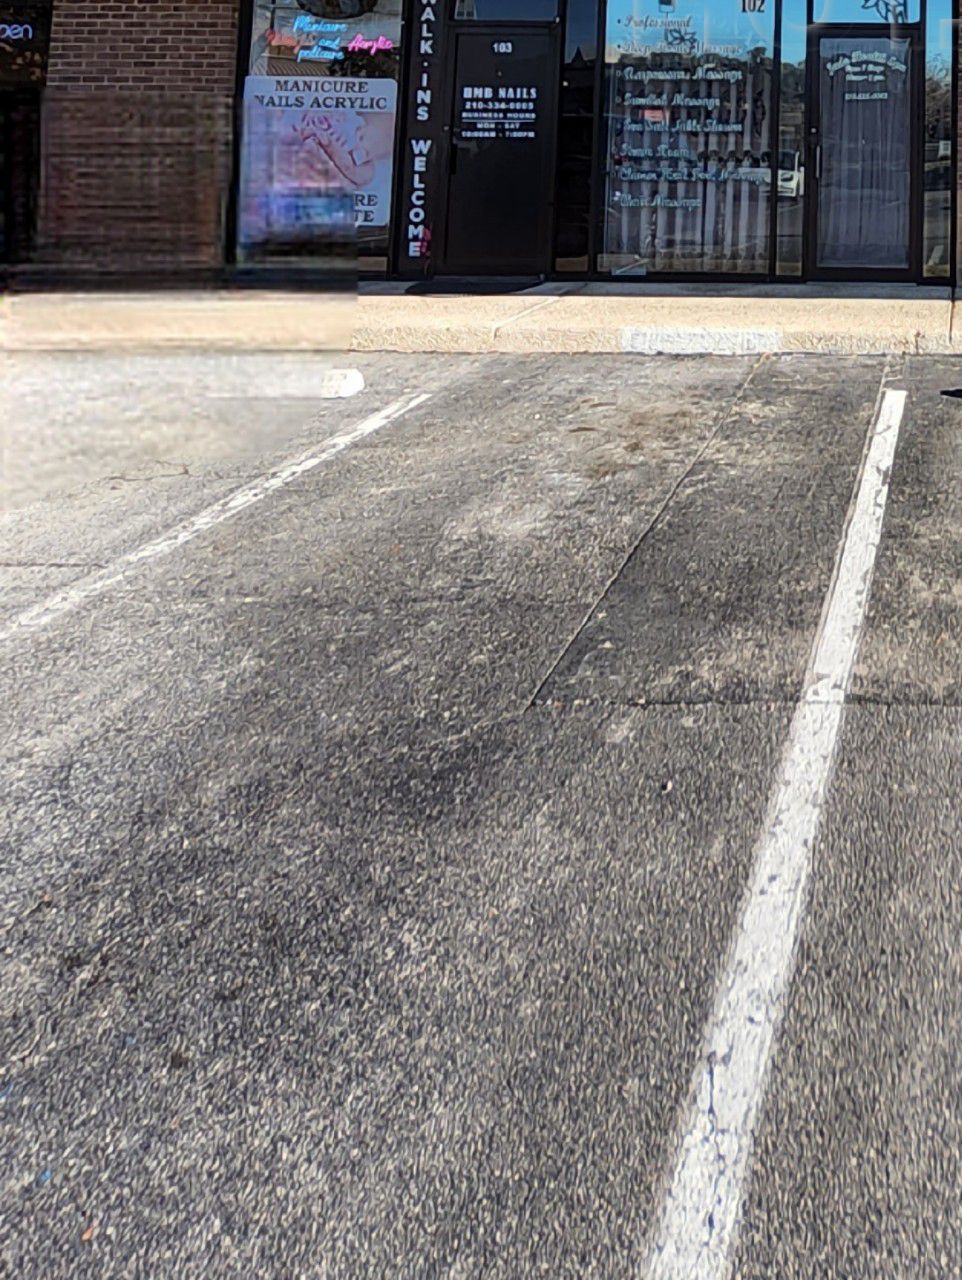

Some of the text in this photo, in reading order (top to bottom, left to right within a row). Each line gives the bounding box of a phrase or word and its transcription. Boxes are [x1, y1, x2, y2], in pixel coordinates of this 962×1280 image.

[492, 41, 513, 54] 103
[274, 80, 369, 94] MANICURE
[498, 87, 537, 99] NAILS
[310, 96, 388, 110] ACRYLIC
[408, 139, 432, 257] WELCOME
